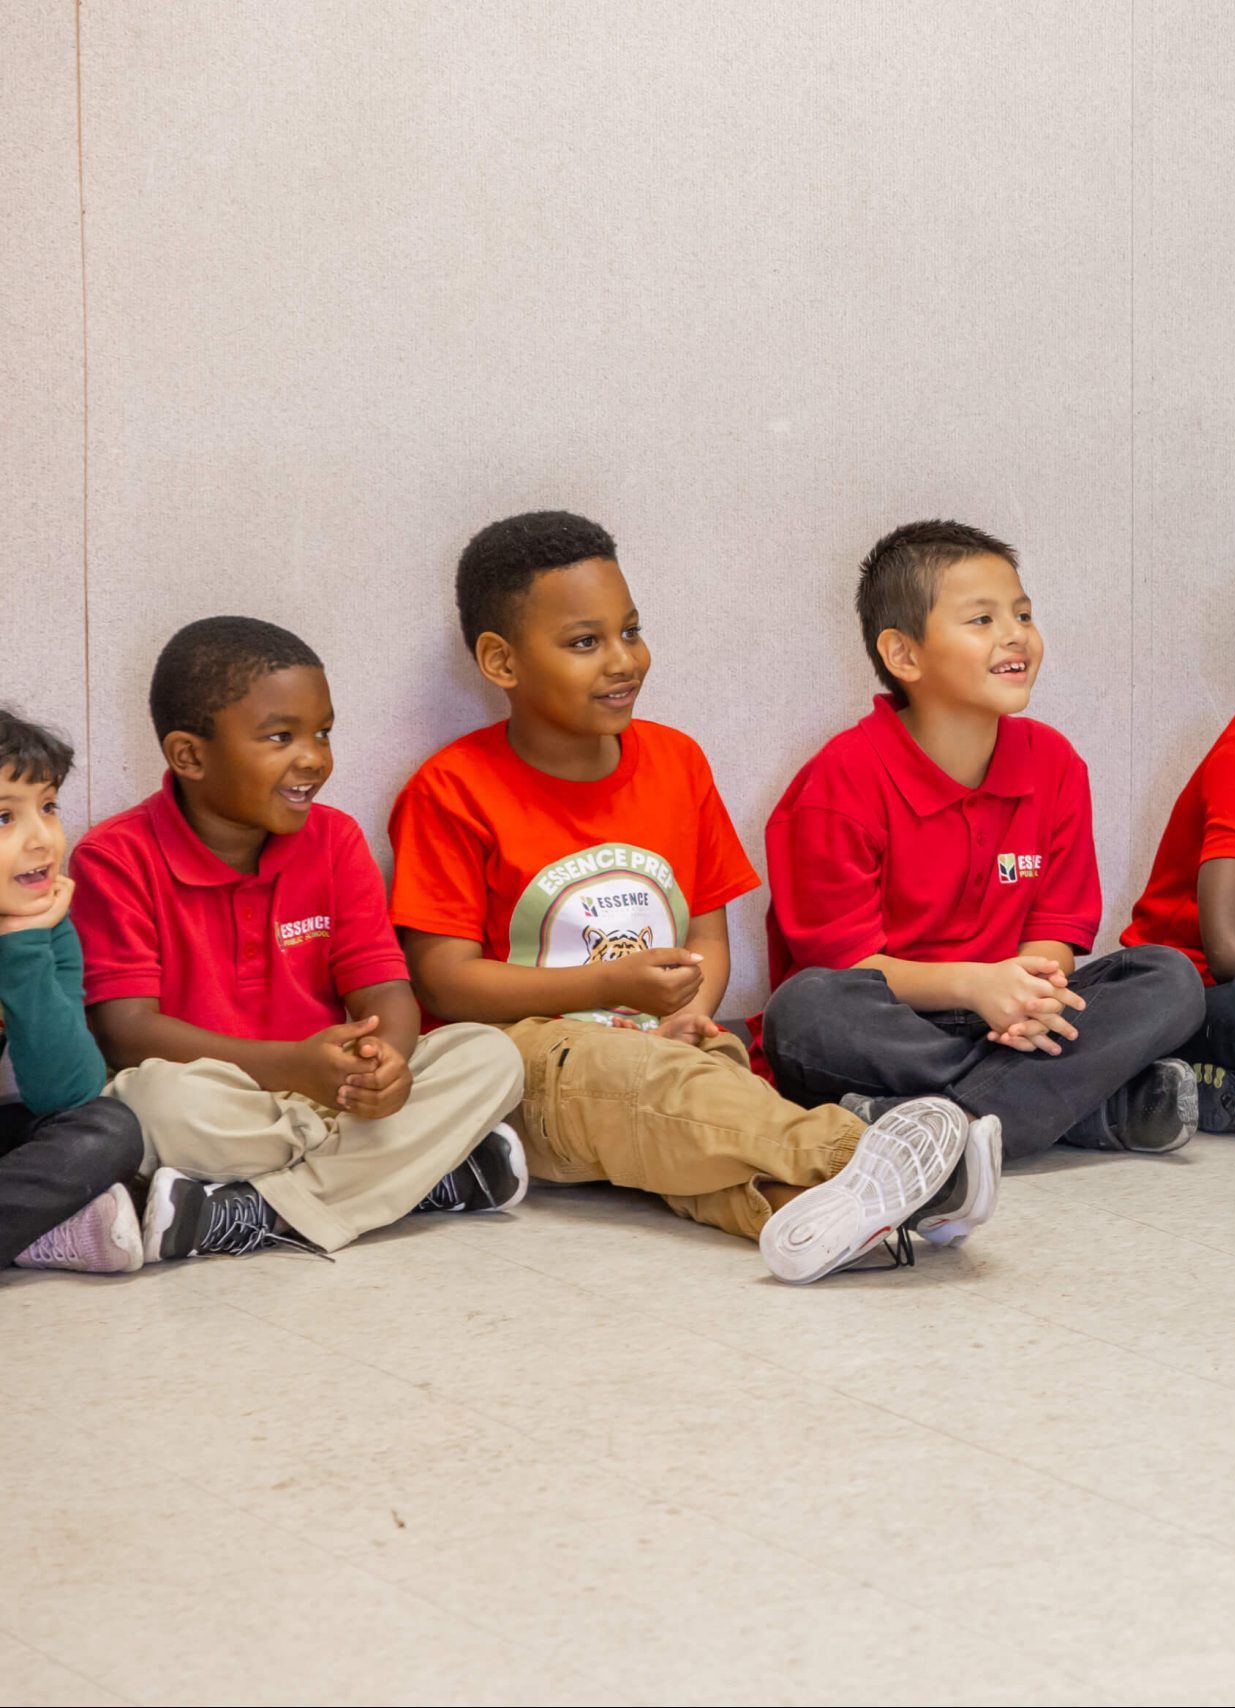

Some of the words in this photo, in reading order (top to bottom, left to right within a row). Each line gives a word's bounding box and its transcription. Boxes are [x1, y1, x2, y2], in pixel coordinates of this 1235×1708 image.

[538, 848, 627, 896] ESSENCE
[597, 892, 648, 908] ESSENCE
[281, 915, 331, 939] ESSENCE
